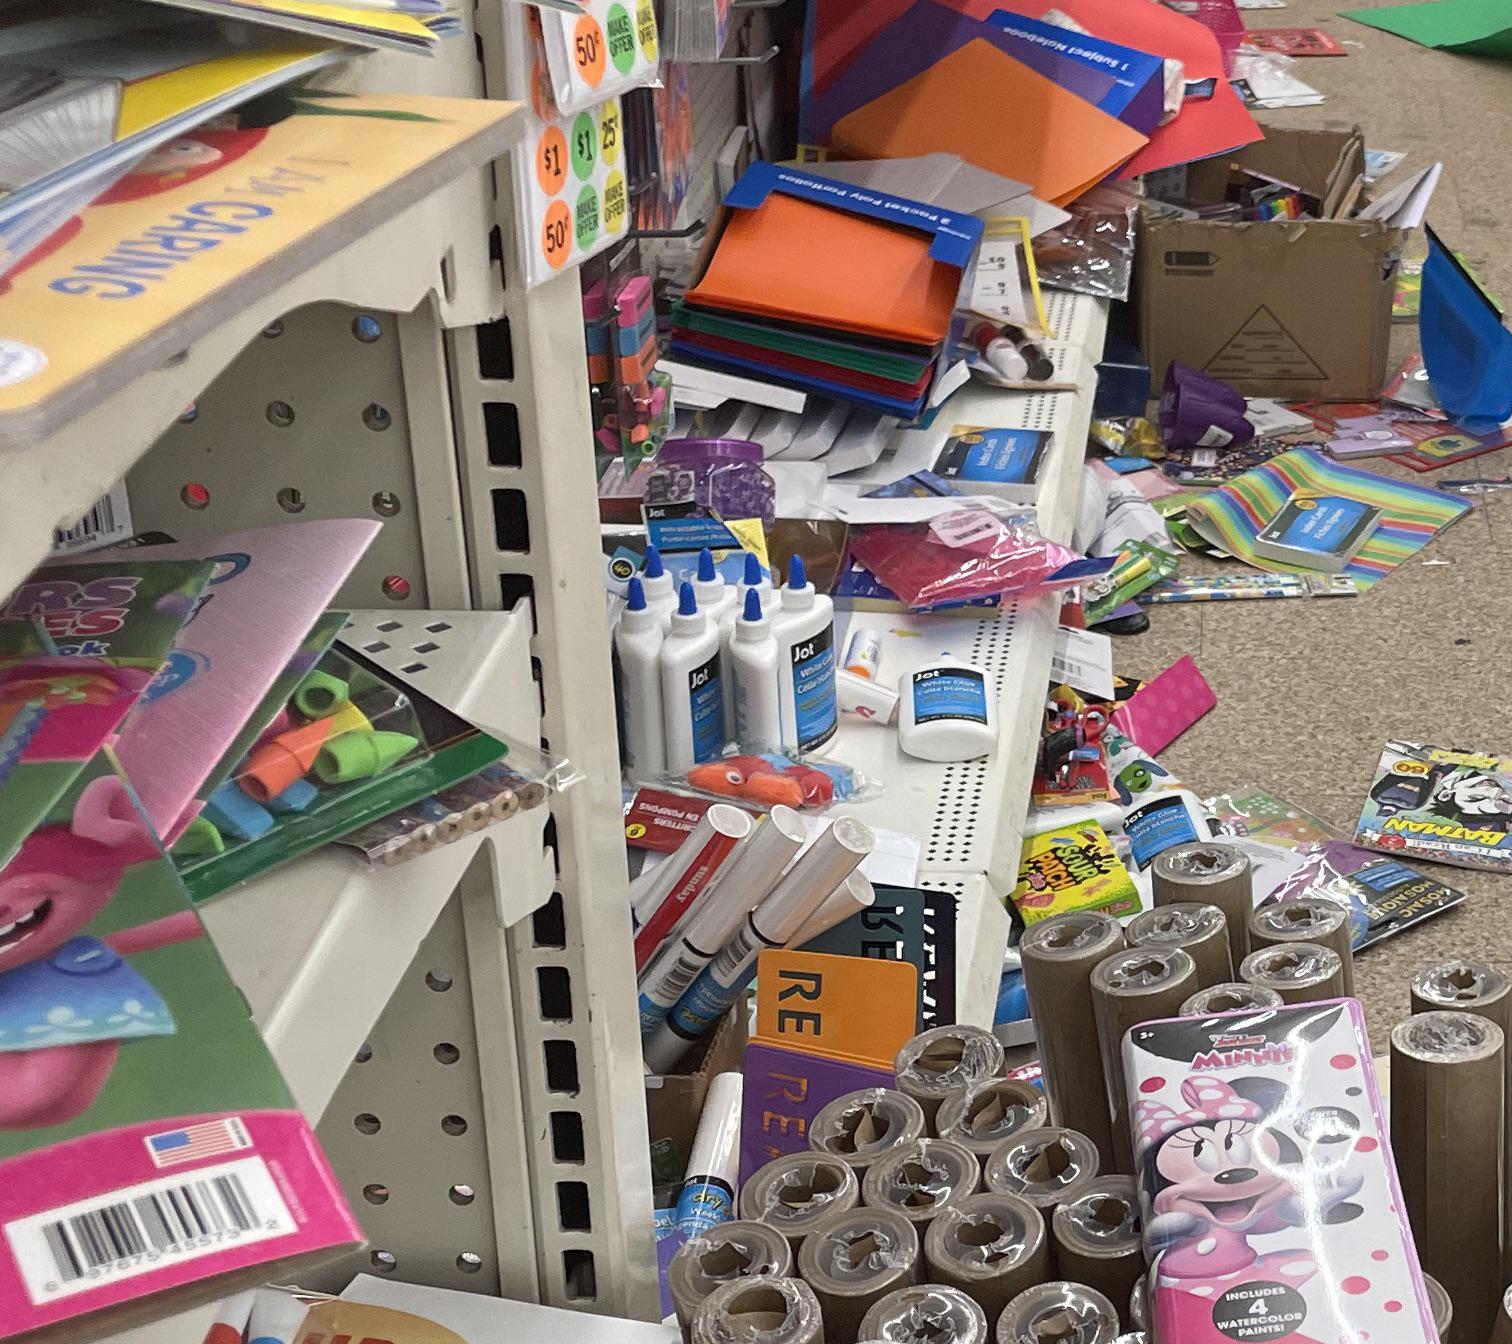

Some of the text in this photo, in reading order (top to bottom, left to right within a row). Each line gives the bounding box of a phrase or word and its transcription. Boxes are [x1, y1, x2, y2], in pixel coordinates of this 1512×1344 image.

[608, 17, 629, 36] MAKE
[576, 31, 599, 66] 50¢
[610, 37, 635, 59] OFFER
[577, 129, 593, 162] $1
[545, 143, 561, 177] $1
[48, 201, 273, 300] CARING
[794, 641, 815, 662] Jot
[691, 668, 710, 689] Jot
[915, 669, 940, 682] Jot
[1124, 810, 1144, 828] Jot
[1383, 816, 1507, 846] BATMAN
[1029, 854, 1077, 892] PATCH
[1056, 845, 1101, 880] SOUR
[777, 969, 823, 1037] RE
[1225, 1287, 1287, 1302] INCLUDES
[1248, 1298, 1269, 1316] 4
[1217, 1312, 1303, 1331] WATERCOLOR
[1238, 1324, 1285, 1337] PAINTS!
